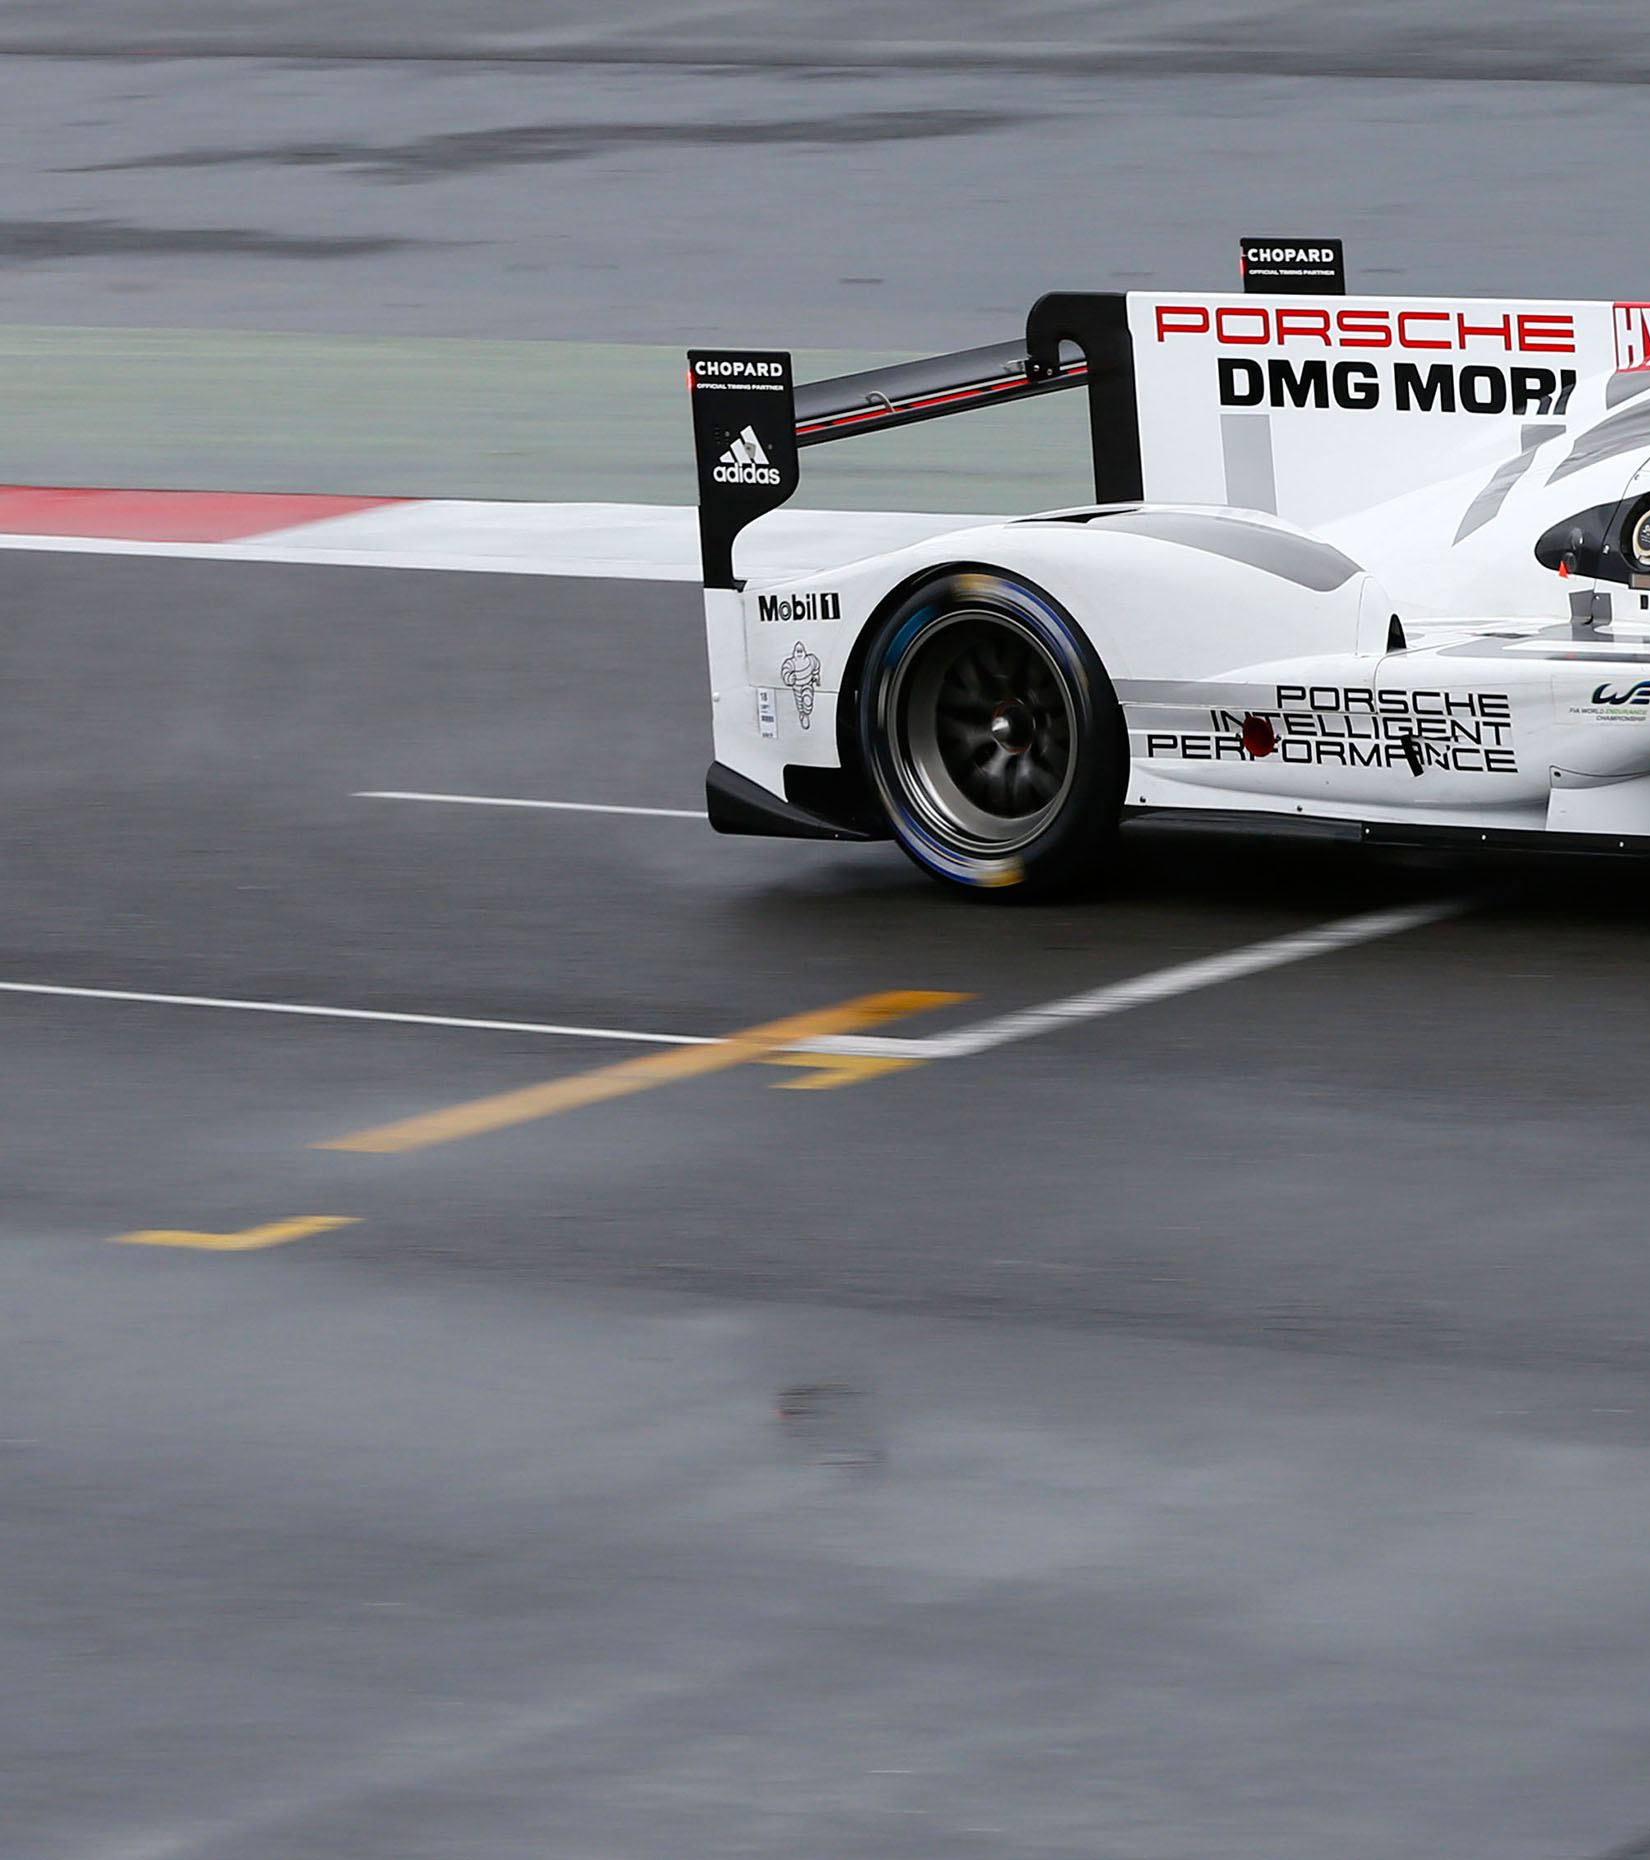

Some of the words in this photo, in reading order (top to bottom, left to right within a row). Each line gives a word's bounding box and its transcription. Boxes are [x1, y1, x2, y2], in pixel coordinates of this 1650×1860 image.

[1248, 248, 1334, 262] CHOPARD
[1155, 305, 1575, 353] PORSCHE
[695, 361, 783, 377] CHOPARD
[1217, 358, 1379, 409] DMG
[1394, 363, 1576, 415] MORI
[713, 463, 781, 485] adidas
[758, 593, 818, 622] Mobil
[1277, 685, 1511, 718] PORSCHE
[1210, 709, 1511, 745] INTELLIGENT
[1147, 734, 1519, 773] PERORMANCE
